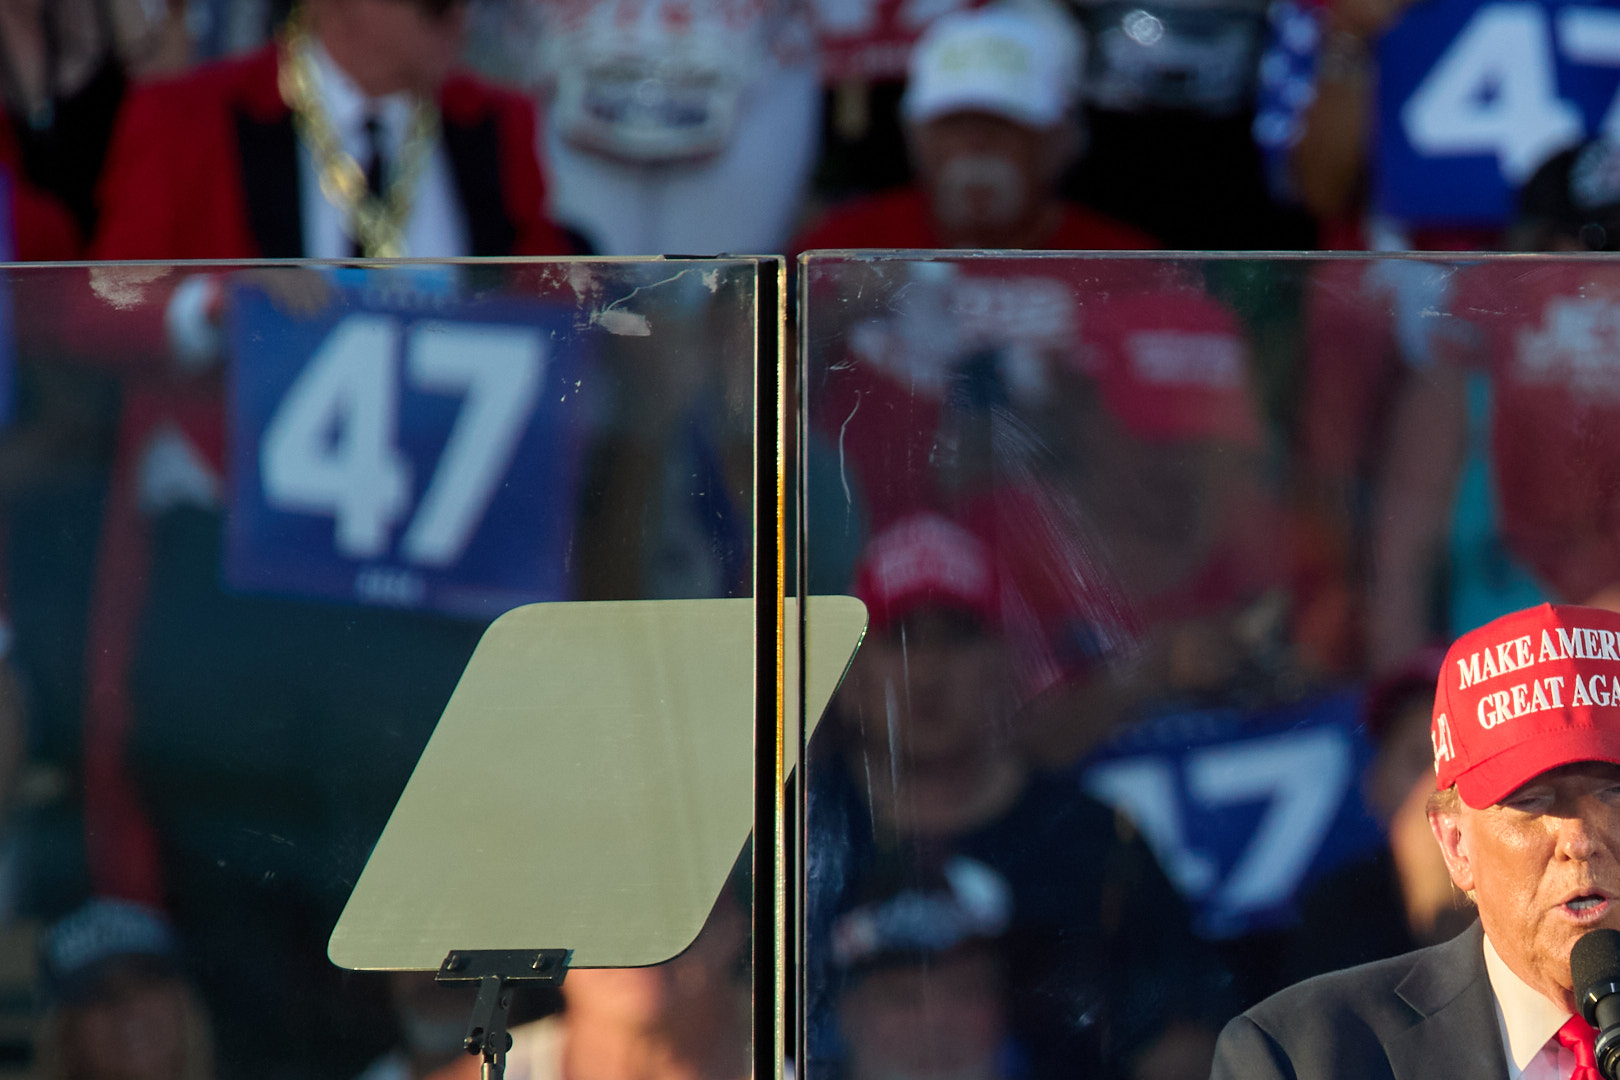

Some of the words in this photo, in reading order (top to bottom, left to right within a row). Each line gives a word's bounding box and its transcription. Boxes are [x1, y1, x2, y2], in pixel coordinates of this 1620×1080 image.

[259, 313, 546, 567] 47
[1457, 635, 1535, 690] MAKE
[1477, 676, 1565, 730] GREAT
